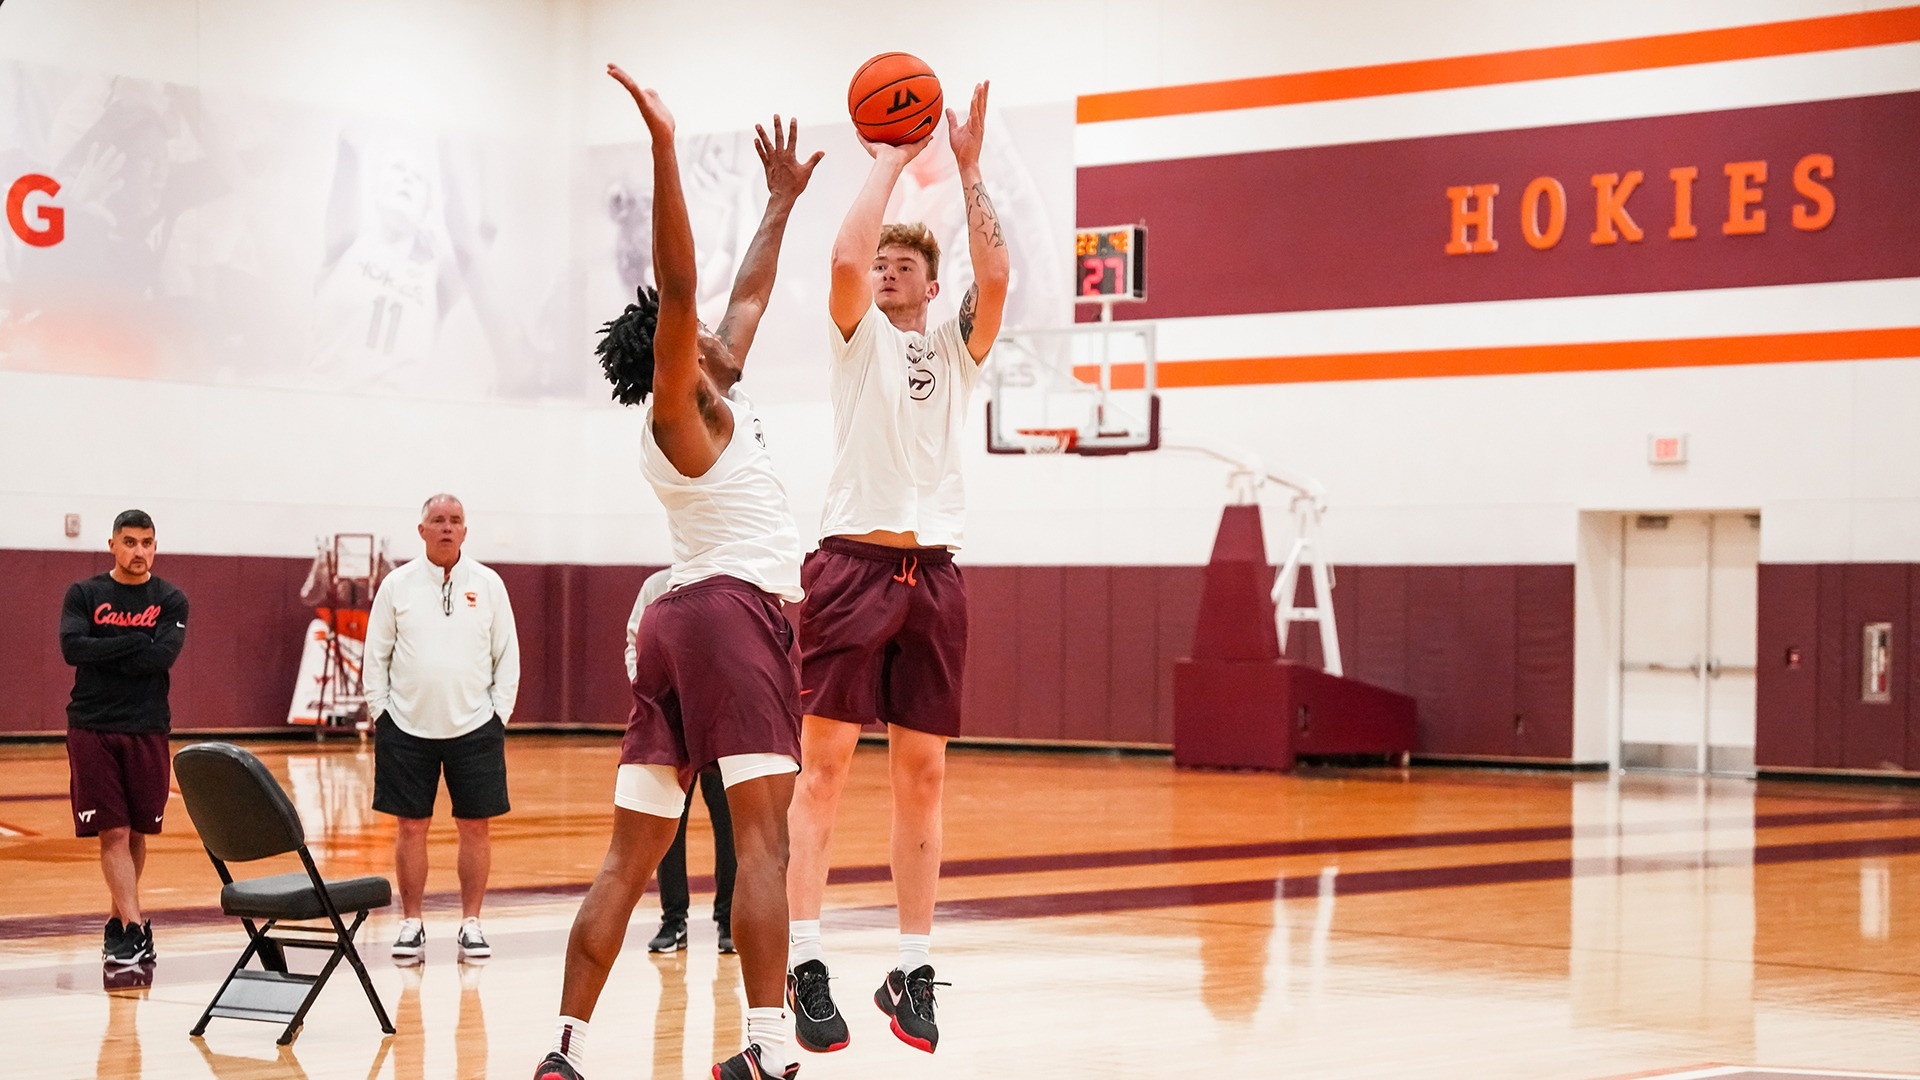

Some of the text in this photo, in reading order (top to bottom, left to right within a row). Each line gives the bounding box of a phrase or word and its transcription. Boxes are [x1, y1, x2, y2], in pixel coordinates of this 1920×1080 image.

[6, 173, 65, 248] G
[1444, 153, 1836, 255] HOKIES
[1083, 257, 1124, 297] 27
[366, 295, 403, 356] 11
[94, 602, 161, 627] Cassell
[78, 809, 97, 823] VT
